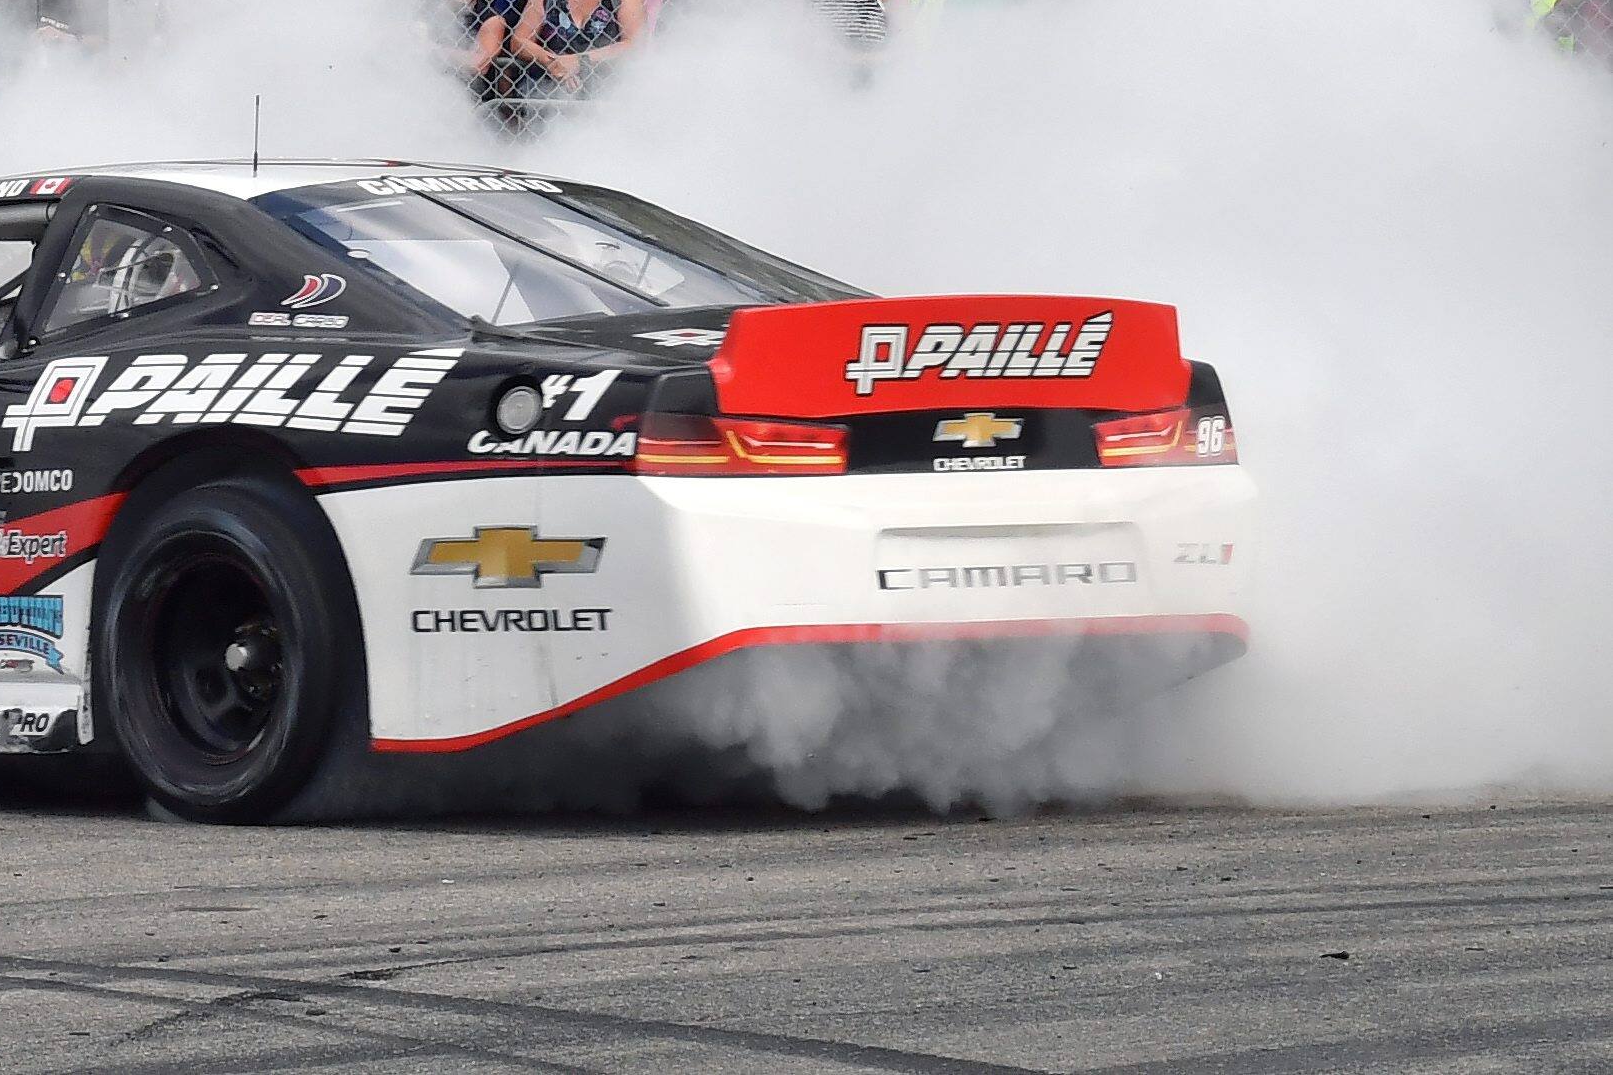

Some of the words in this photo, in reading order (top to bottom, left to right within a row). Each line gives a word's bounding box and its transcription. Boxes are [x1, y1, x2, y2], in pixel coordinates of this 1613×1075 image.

[904, 311, 1114, 378] PAILLÉ
[81, 348, 466, 436] PAILLÉ
[467, 430, 638, 457] CANADA
[1196, 416, 1226, 457] 96
[933, 455, 1026, 471] CHEVROLET
[876, 561, 1137, 591] CAMARO
[412, 608, 613, 633] CHEVROLET
